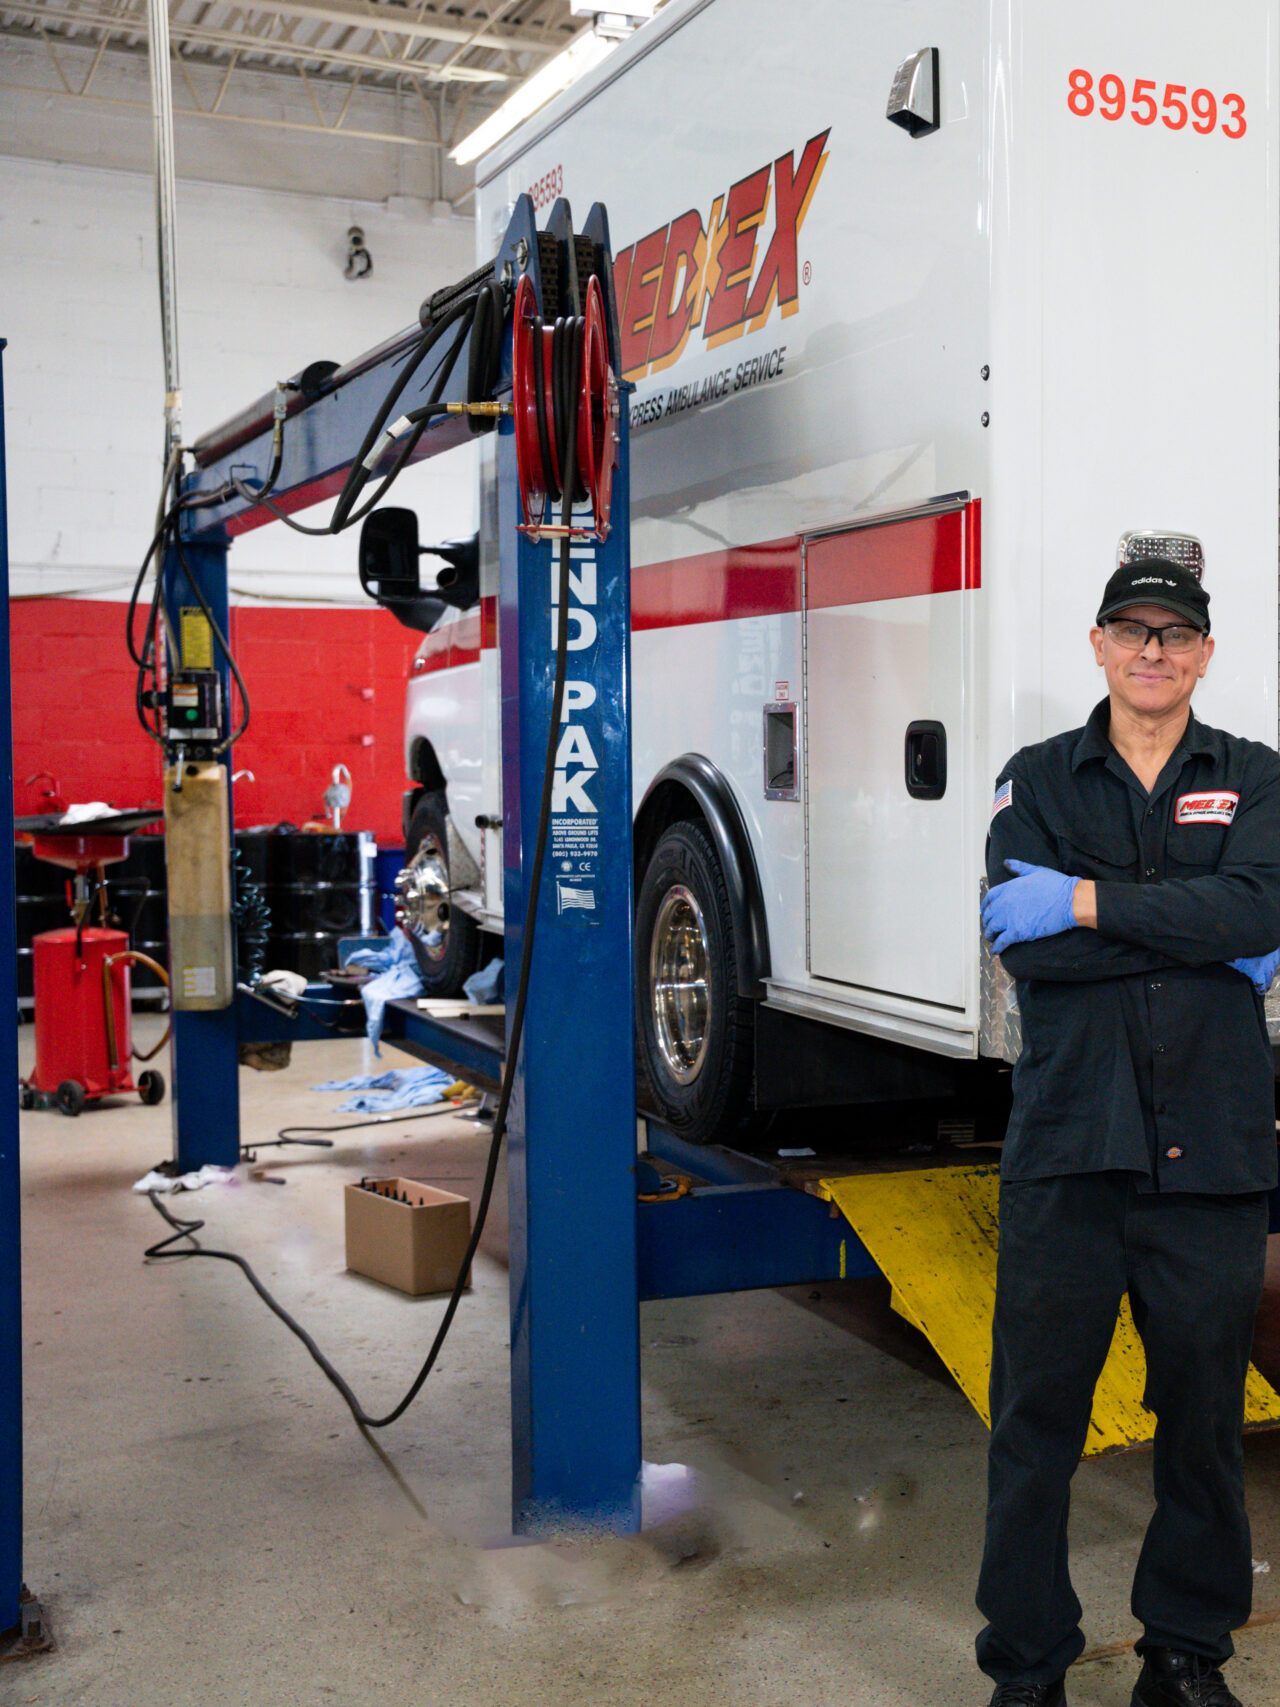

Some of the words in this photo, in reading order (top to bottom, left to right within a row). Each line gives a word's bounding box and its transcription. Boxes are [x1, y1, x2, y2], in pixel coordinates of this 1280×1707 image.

[1067, 68, 1247, 139] 895593
[629, 395, 663, 429] PRESS
[665, 368, 732, 416] AMBULANCE
[734, 346, 787, 391] SERVICE
[550, 500, 597, 651] END
[1131, 576, 1163, 586] adidas
[551, 680, 599, 812] PAK
